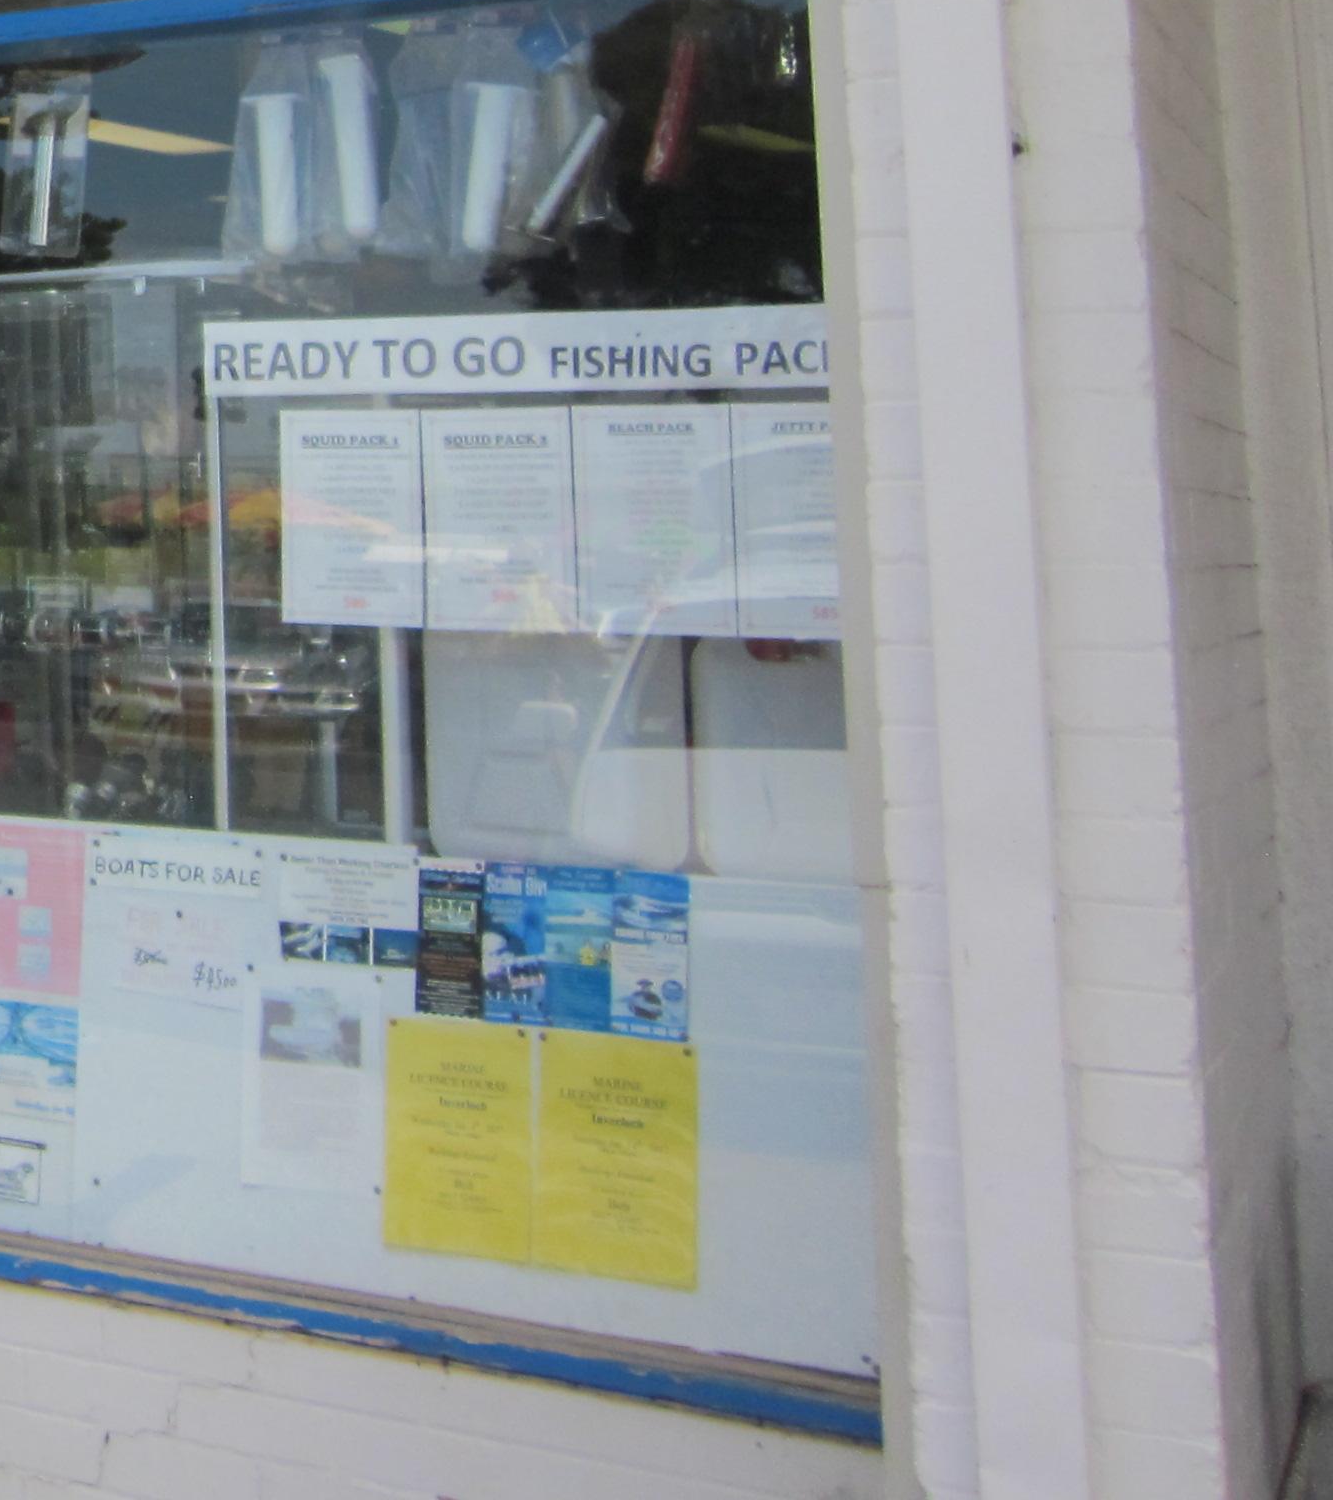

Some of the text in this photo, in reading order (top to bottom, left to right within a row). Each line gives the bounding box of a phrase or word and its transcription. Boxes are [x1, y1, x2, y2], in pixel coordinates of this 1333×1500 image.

[213, 336, 828, 382] READY TO GO FISHING PAC
[608, 422, 695, 434] BEACH PACK
[301, 434, 348, 446] SQUID
[350, 434, 389, 446] PACK
[443, 434, 491, 446] SQUID
[495, 434, 536, 446] PACK
[95, 856, 261, 887] BOATS FOR SALE
